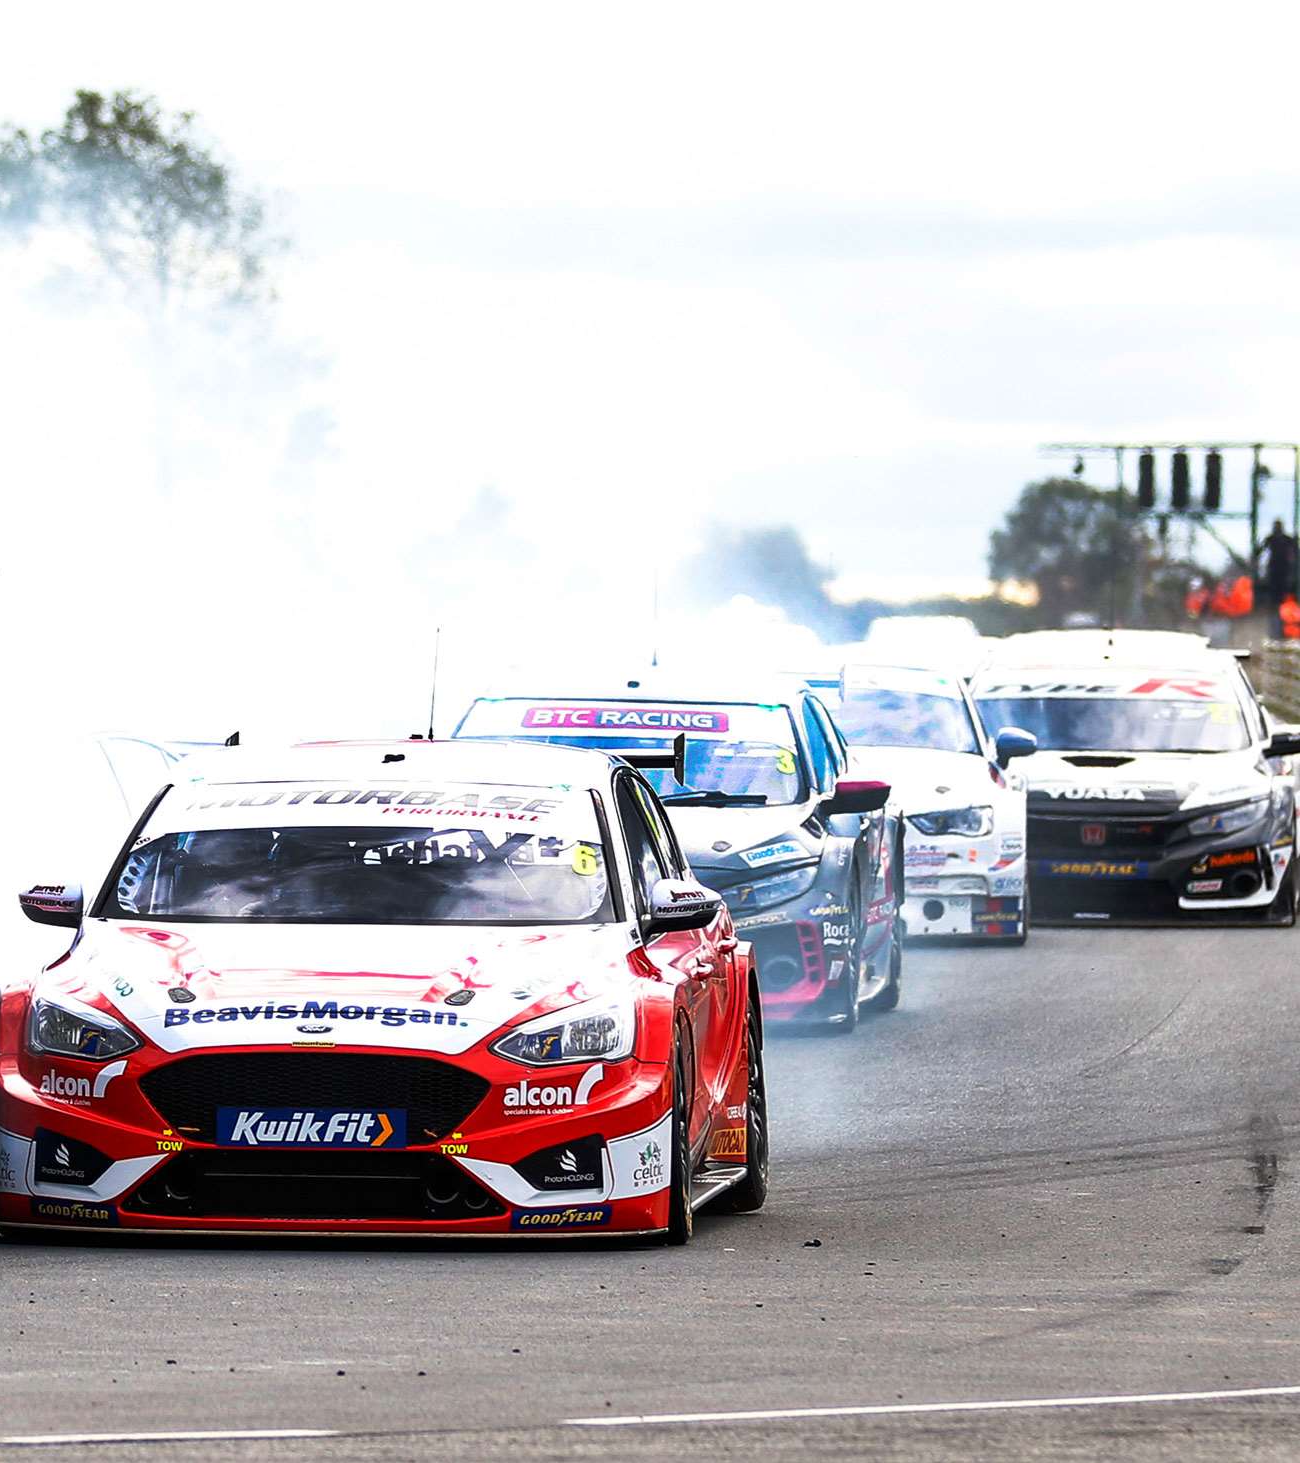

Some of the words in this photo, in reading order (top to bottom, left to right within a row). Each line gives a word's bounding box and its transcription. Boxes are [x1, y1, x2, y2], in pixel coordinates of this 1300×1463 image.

[1128, 678, 1217, 698] R
[532, 710, 591, 726] BTC
[601, 710, 714, 729] RACING
[776, 749, 796, 774] 3
[572, 844, 597, 876] 6
[40, 1069, 90, 1097] alcon
[504, 1080, 573, 1106] alcon
[156, 1141, 184, 1152] TOW
[440, 1143, 469, 1155] TOW
[633, 1163, 664, 1181] celtic
[38, 1204, 109, 1219] GOODYEAR
[520, 1209, 604, 1226] GOODYEAR
